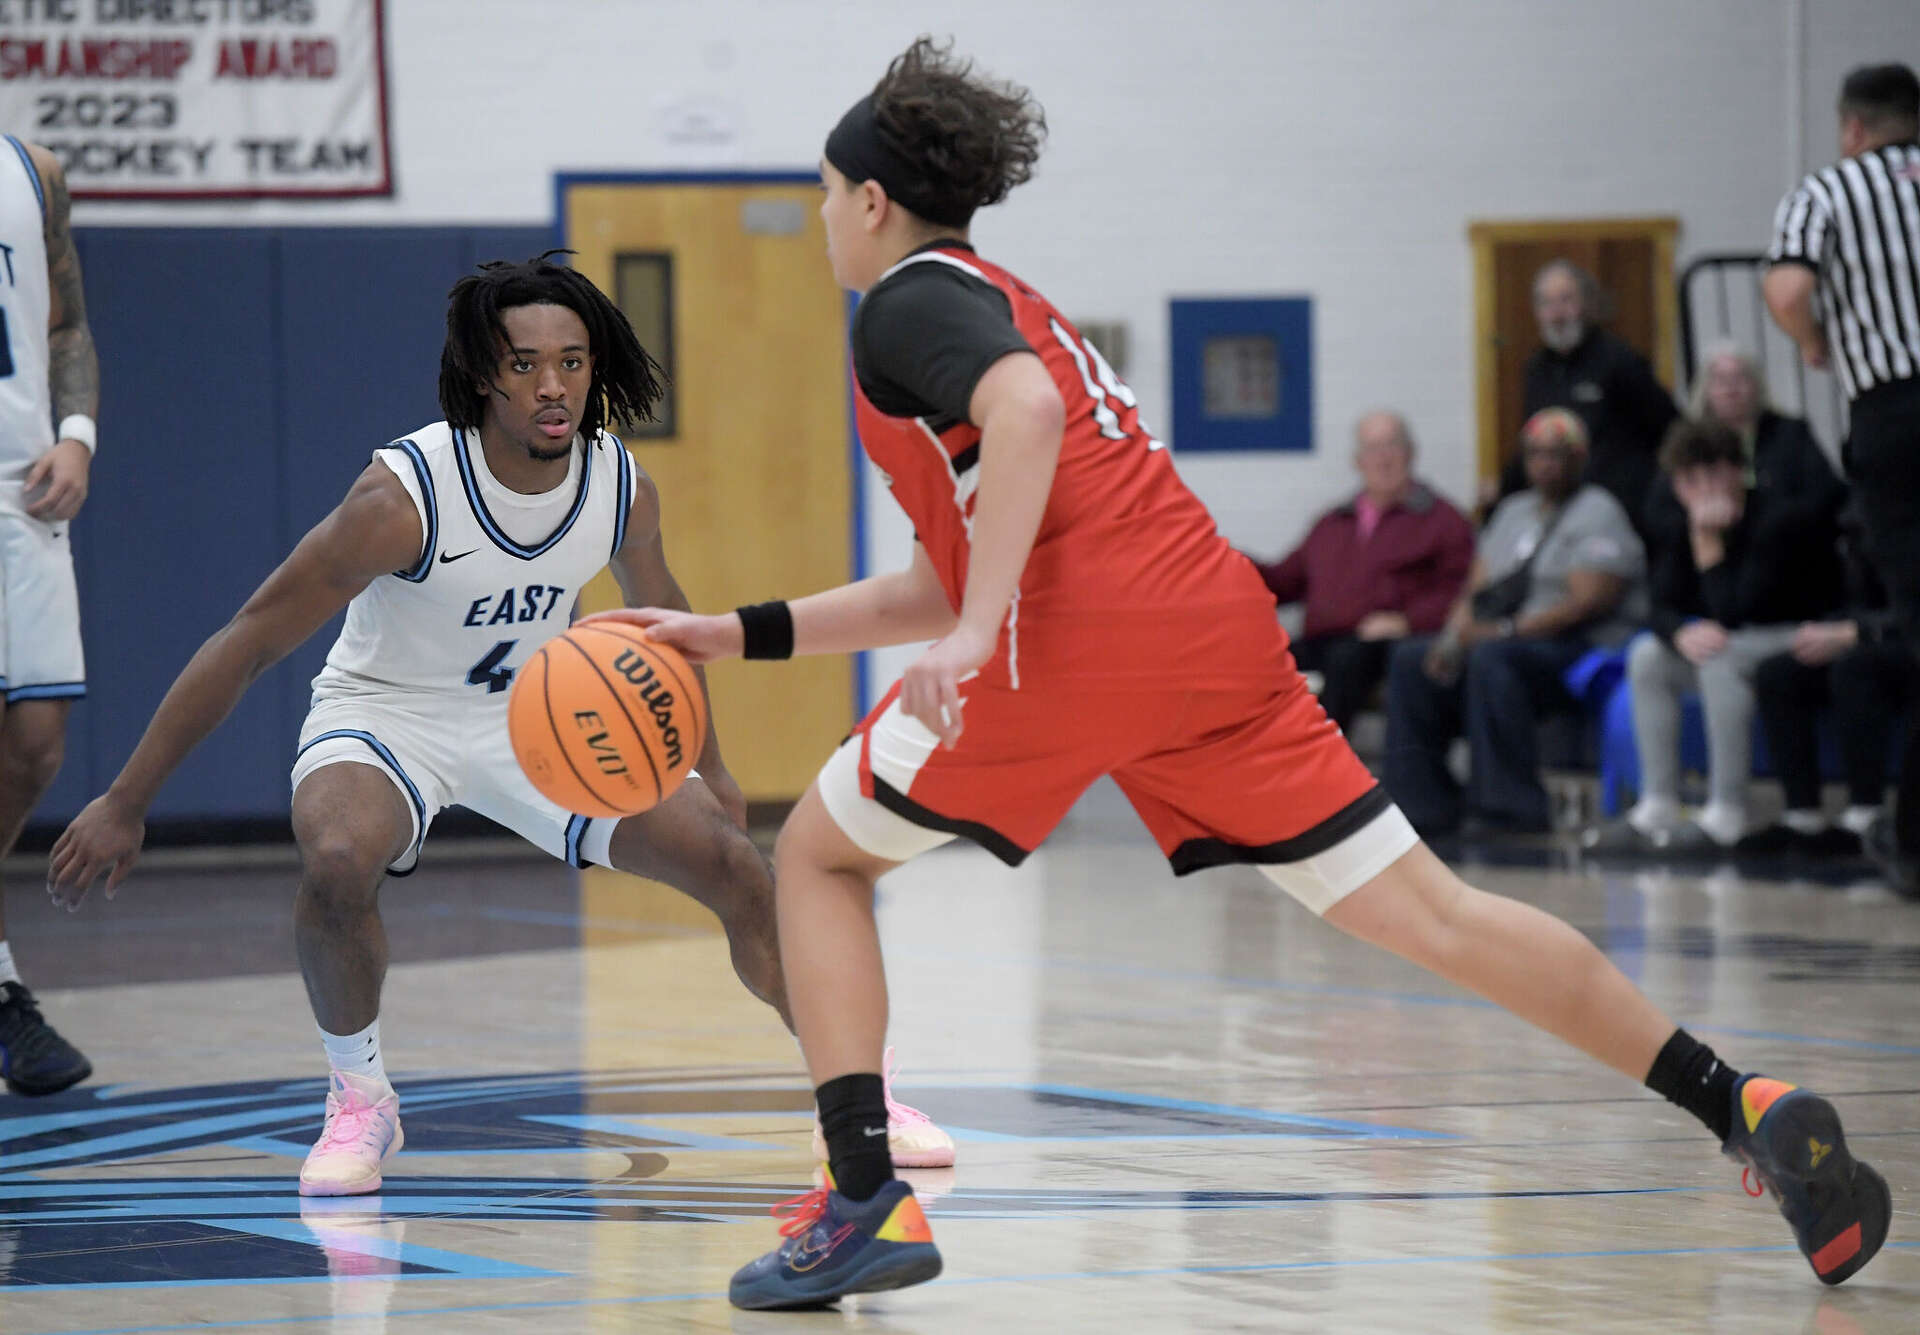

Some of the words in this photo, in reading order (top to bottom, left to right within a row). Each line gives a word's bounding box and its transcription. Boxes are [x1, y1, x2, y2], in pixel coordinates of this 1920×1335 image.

[214, 38, 337, 80] AWARD
[37, 96, 177, 128] 2023
[46, 141, 214, 174] OCKEY
[238, 141, 370, 175] TEAM
[462, 583, 566, 628] EAST
[464, 638, 520, 695] 4
[613, 647, 684, 772] Wilson
